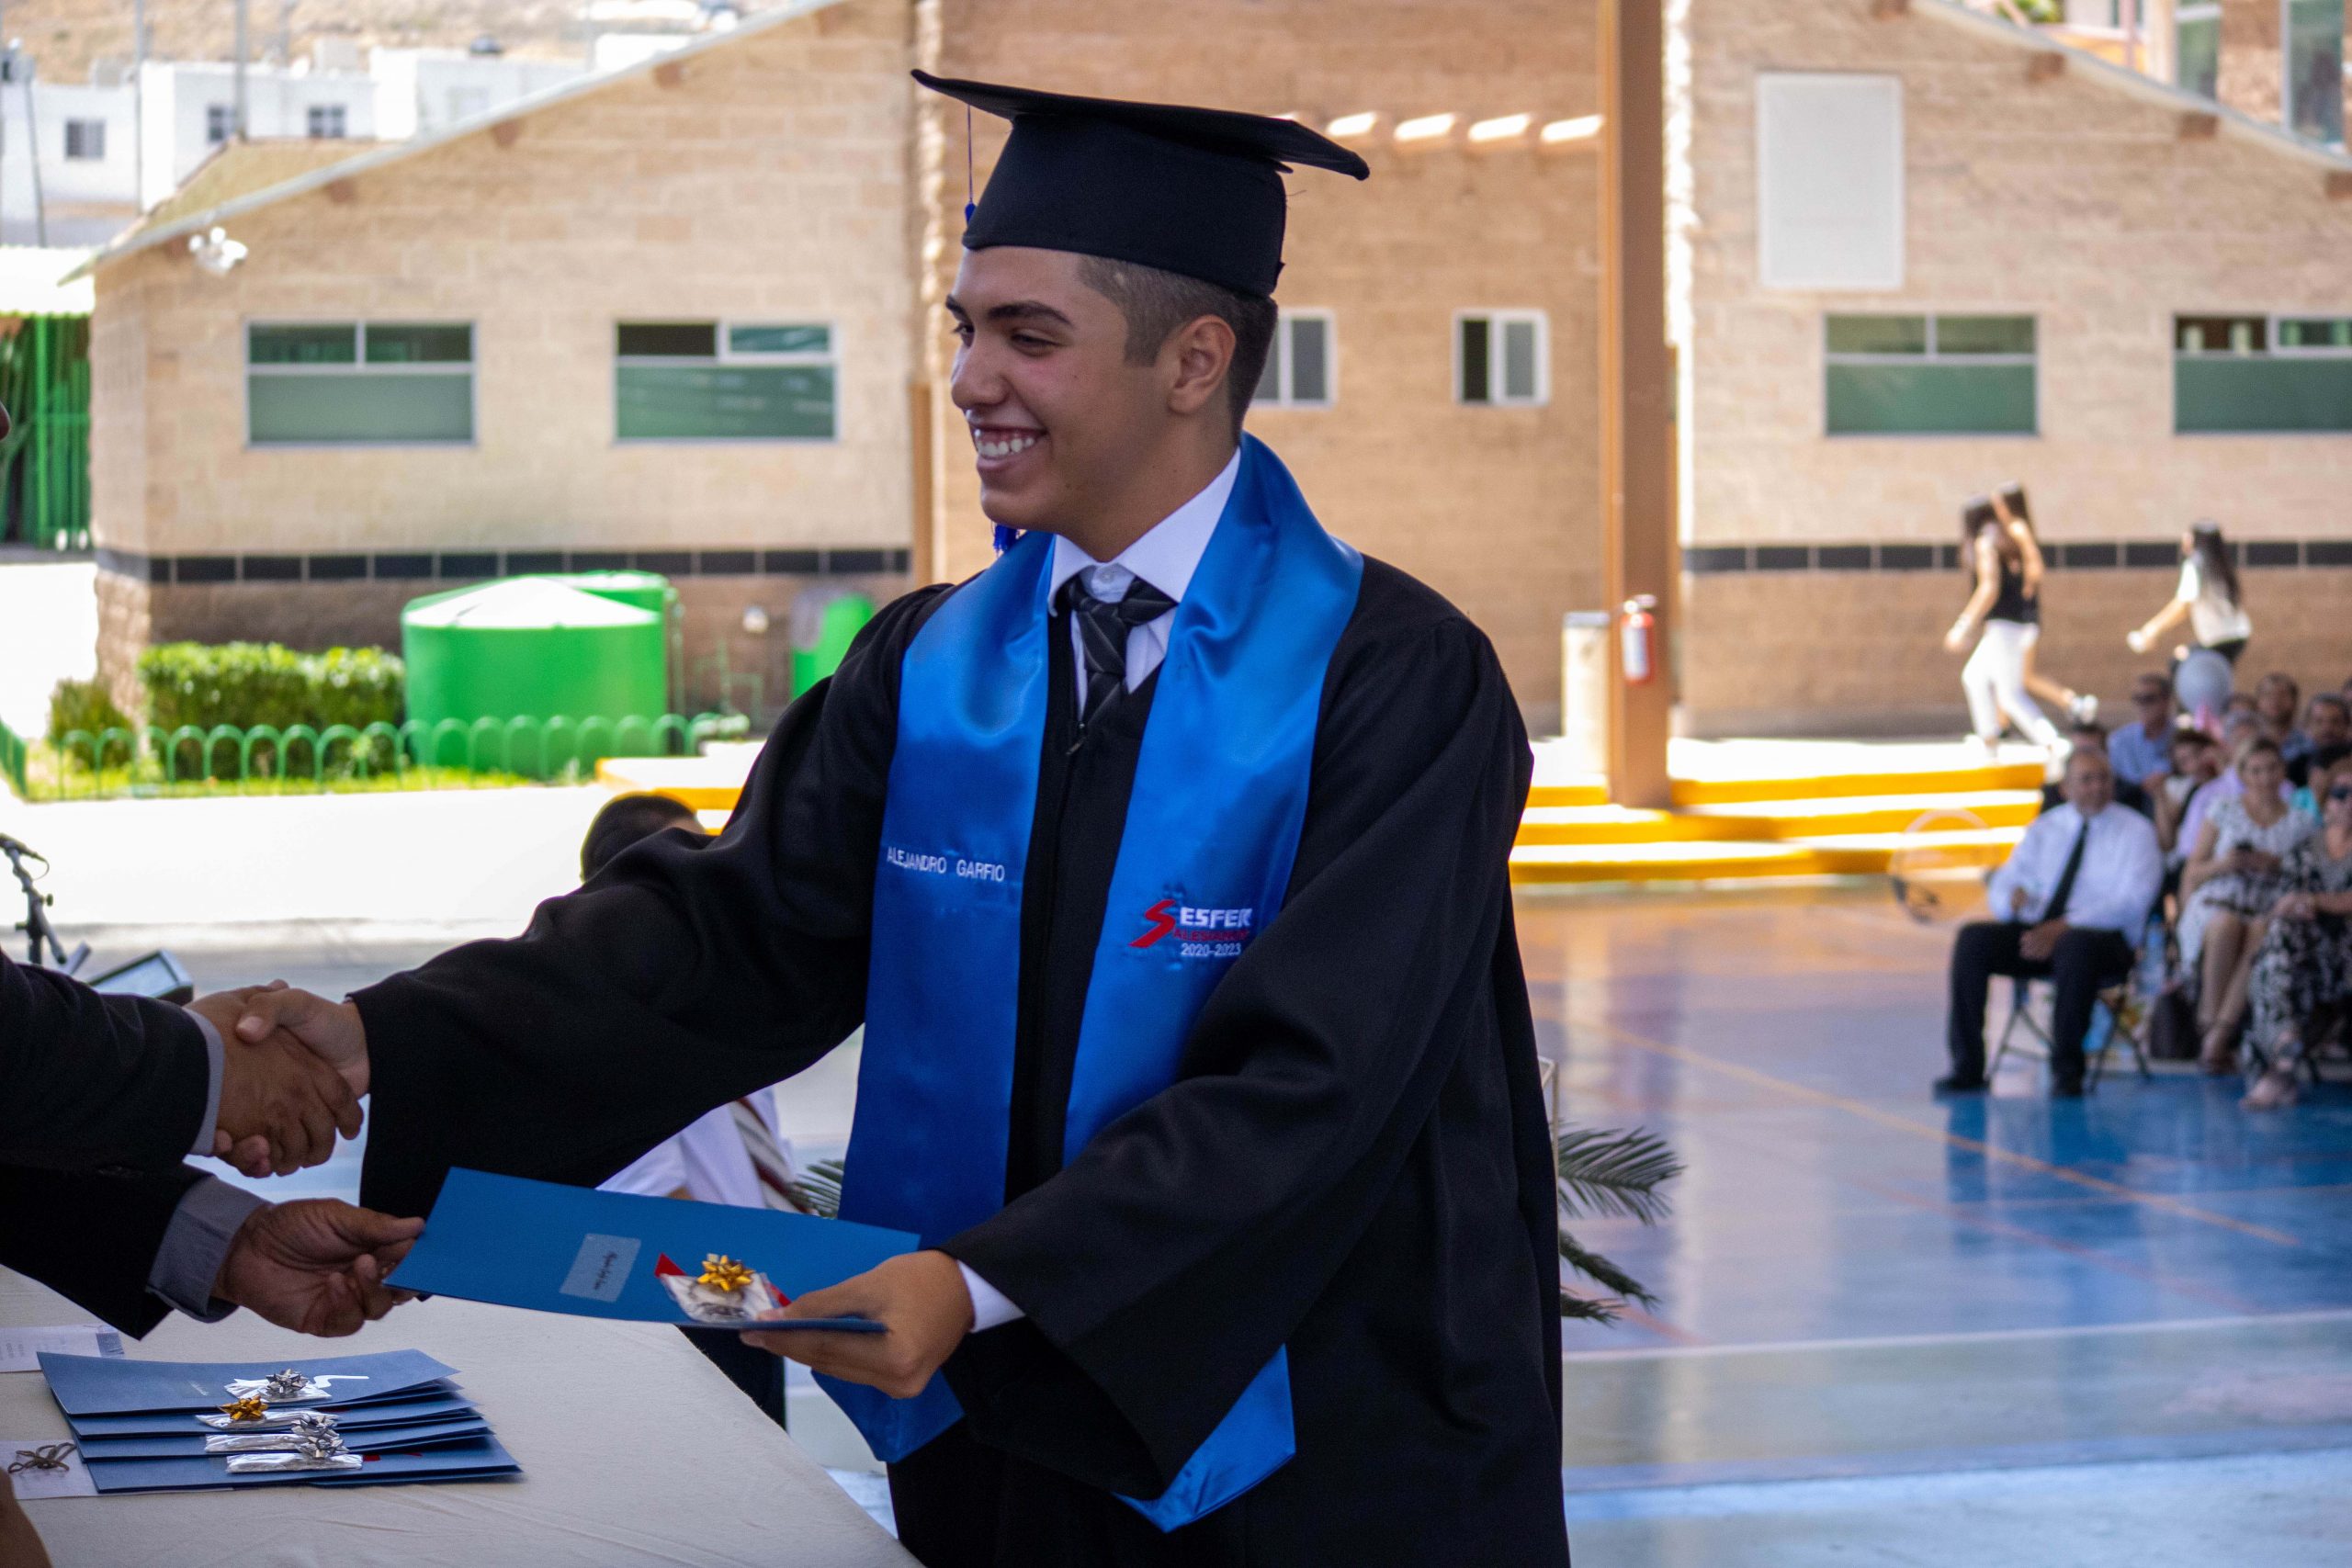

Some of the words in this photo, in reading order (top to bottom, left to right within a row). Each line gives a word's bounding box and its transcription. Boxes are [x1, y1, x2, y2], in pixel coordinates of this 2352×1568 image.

[887, 846, 947, 874] ALEJANDRO
[956, 859, 1005, 882] GARFIO
[1181, 942, 1242, 956] 2020-2023
